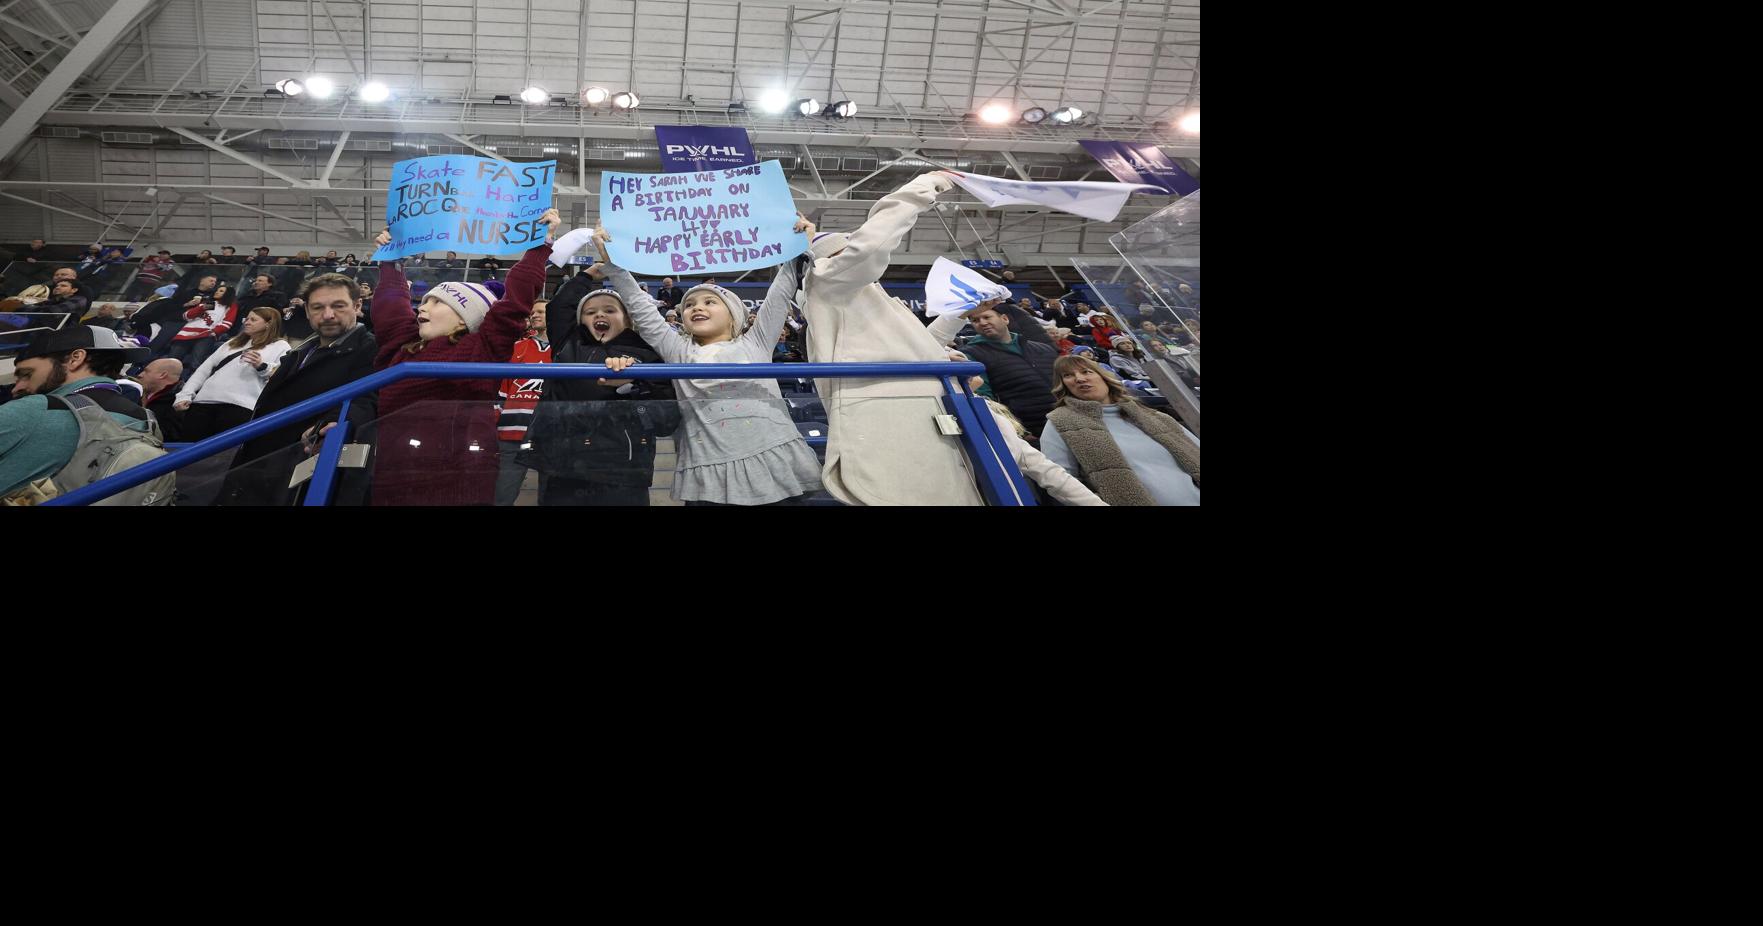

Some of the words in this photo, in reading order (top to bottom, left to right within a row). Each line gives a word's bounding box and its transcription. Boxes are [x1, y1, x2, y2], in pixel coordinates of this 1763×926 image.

[666, 144, 745, 157] PWHL
[400, 160, 465, 184] Skate
[477, 161, 556, 188] FAST
[609, 175, 642, 194] HEY
[650, 175, 688, 188] SARAH
[723, 165, 761, 180] SHARE
[485, 184, 540, 203] Hard
[611, 195, 624, 212] A
[635, 187, 712, 207] BIRTHDAY
[728, 182, 750, 196] ON
[648, 203, 750, 222] JANUARY
[457, 218, 546, 245] NURSE
[635, 233, 691, 254] HAPPY
[700, 226, 759, 248] EARLY
[670, 243, 782, 273] BIRTHDAY
